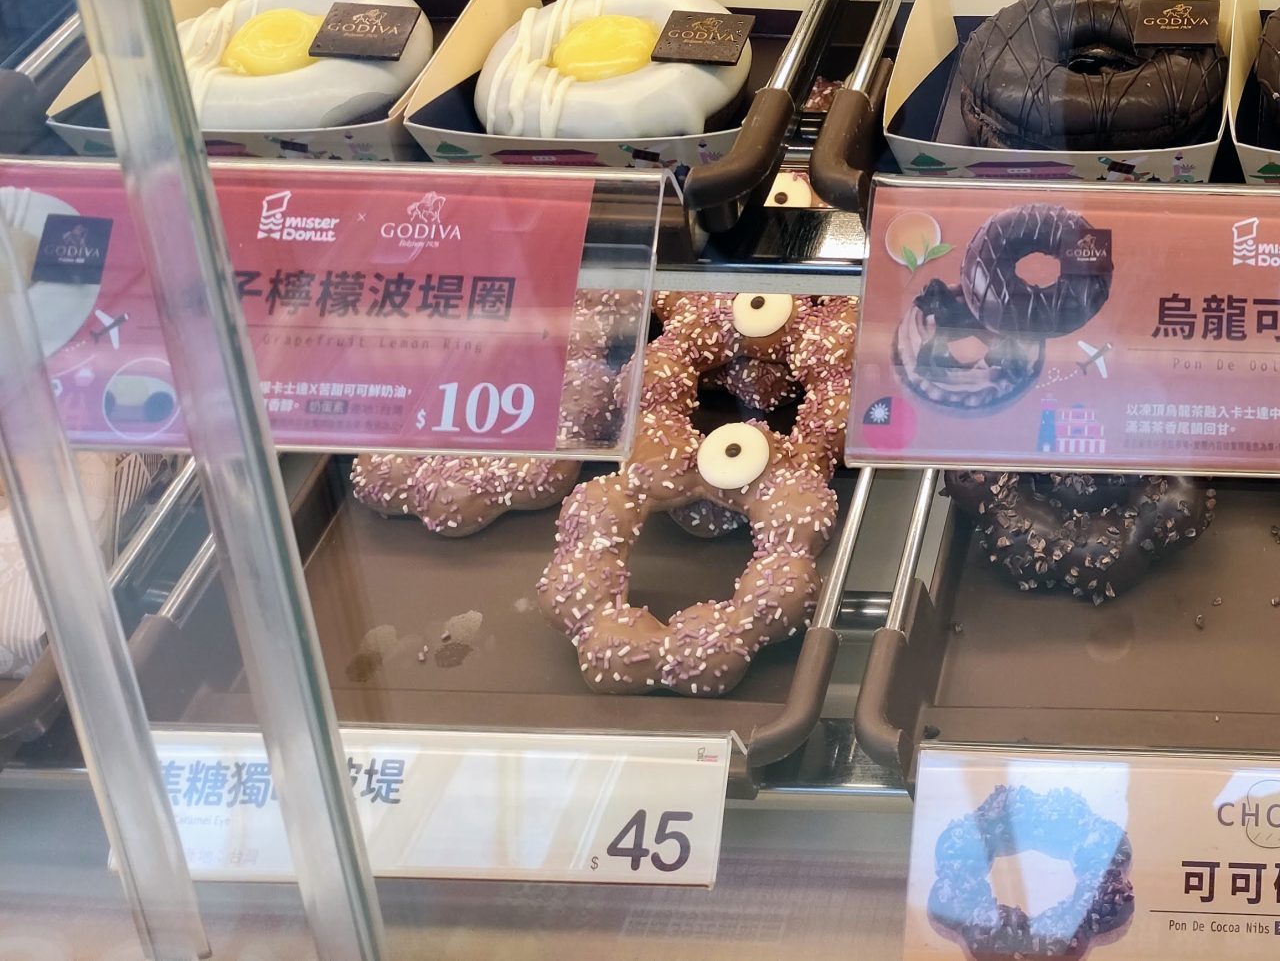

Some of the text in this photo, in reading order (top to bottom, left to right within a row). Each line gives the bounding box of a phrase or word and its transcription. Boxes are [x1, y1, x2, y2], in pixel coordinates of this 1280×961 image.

[1143, 17, 1209, 25] GODIVA
[327, 22, 399, 35] GODIVA
[668, 28, 736, 42] GODIVA
[381, 223, 461, 240] GODIVA
[233, 269, 516, 322] 子檸檬波堤圈
[1173, 357, 1202, 371] Pon
[1216, 358, 1235, 371] De
[415, 381, 535, 434] $109
[1169, 919, 1186, 931] Pon
[1192, 920, 1205, 932] De
[1211, 921, 1240, 933] Cocoa
[1246, 922, 1270, 934] Nibs
